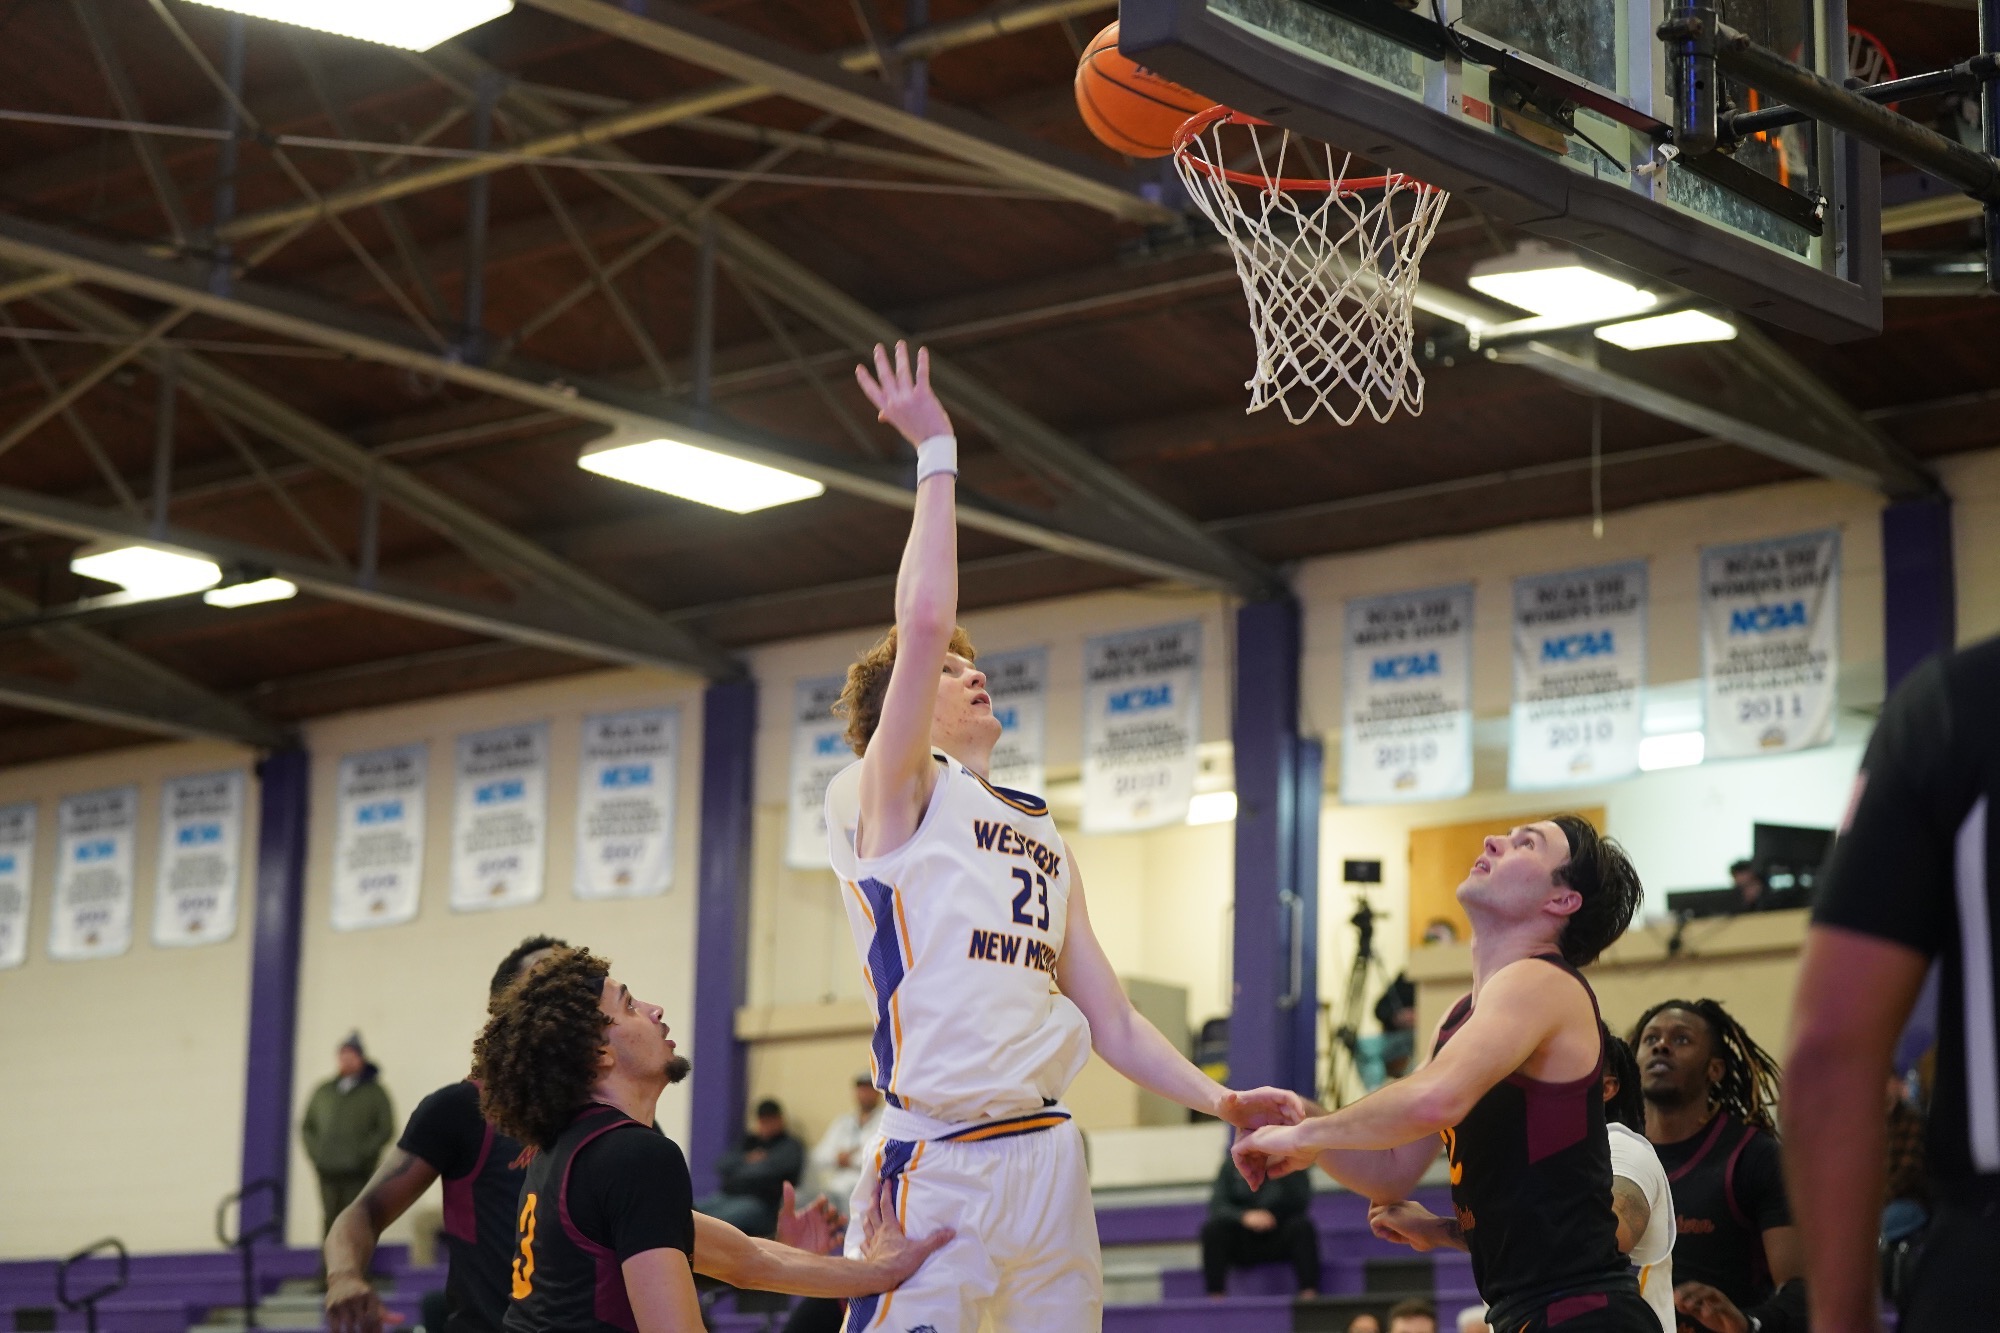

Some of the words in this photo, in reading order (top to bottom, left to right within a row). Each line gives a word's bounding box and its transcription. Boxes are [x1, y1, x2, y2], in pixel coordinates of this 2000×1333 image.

[1731, 601, 1806, 633] NCAA
[1542, 631, 1615, 661] NCAA
[1371, 652, 1441, 680] NCAA
[1108, 684, 1172, 714] NCAA
[1739, 695, 1803, 723] 2011
[1550, 718, 1614, 747] 2010
[1375, 739, 1438, 769] 2010
[1012, 866, 1050, 932] 23
[967, 929, 1022, 965] NEW
